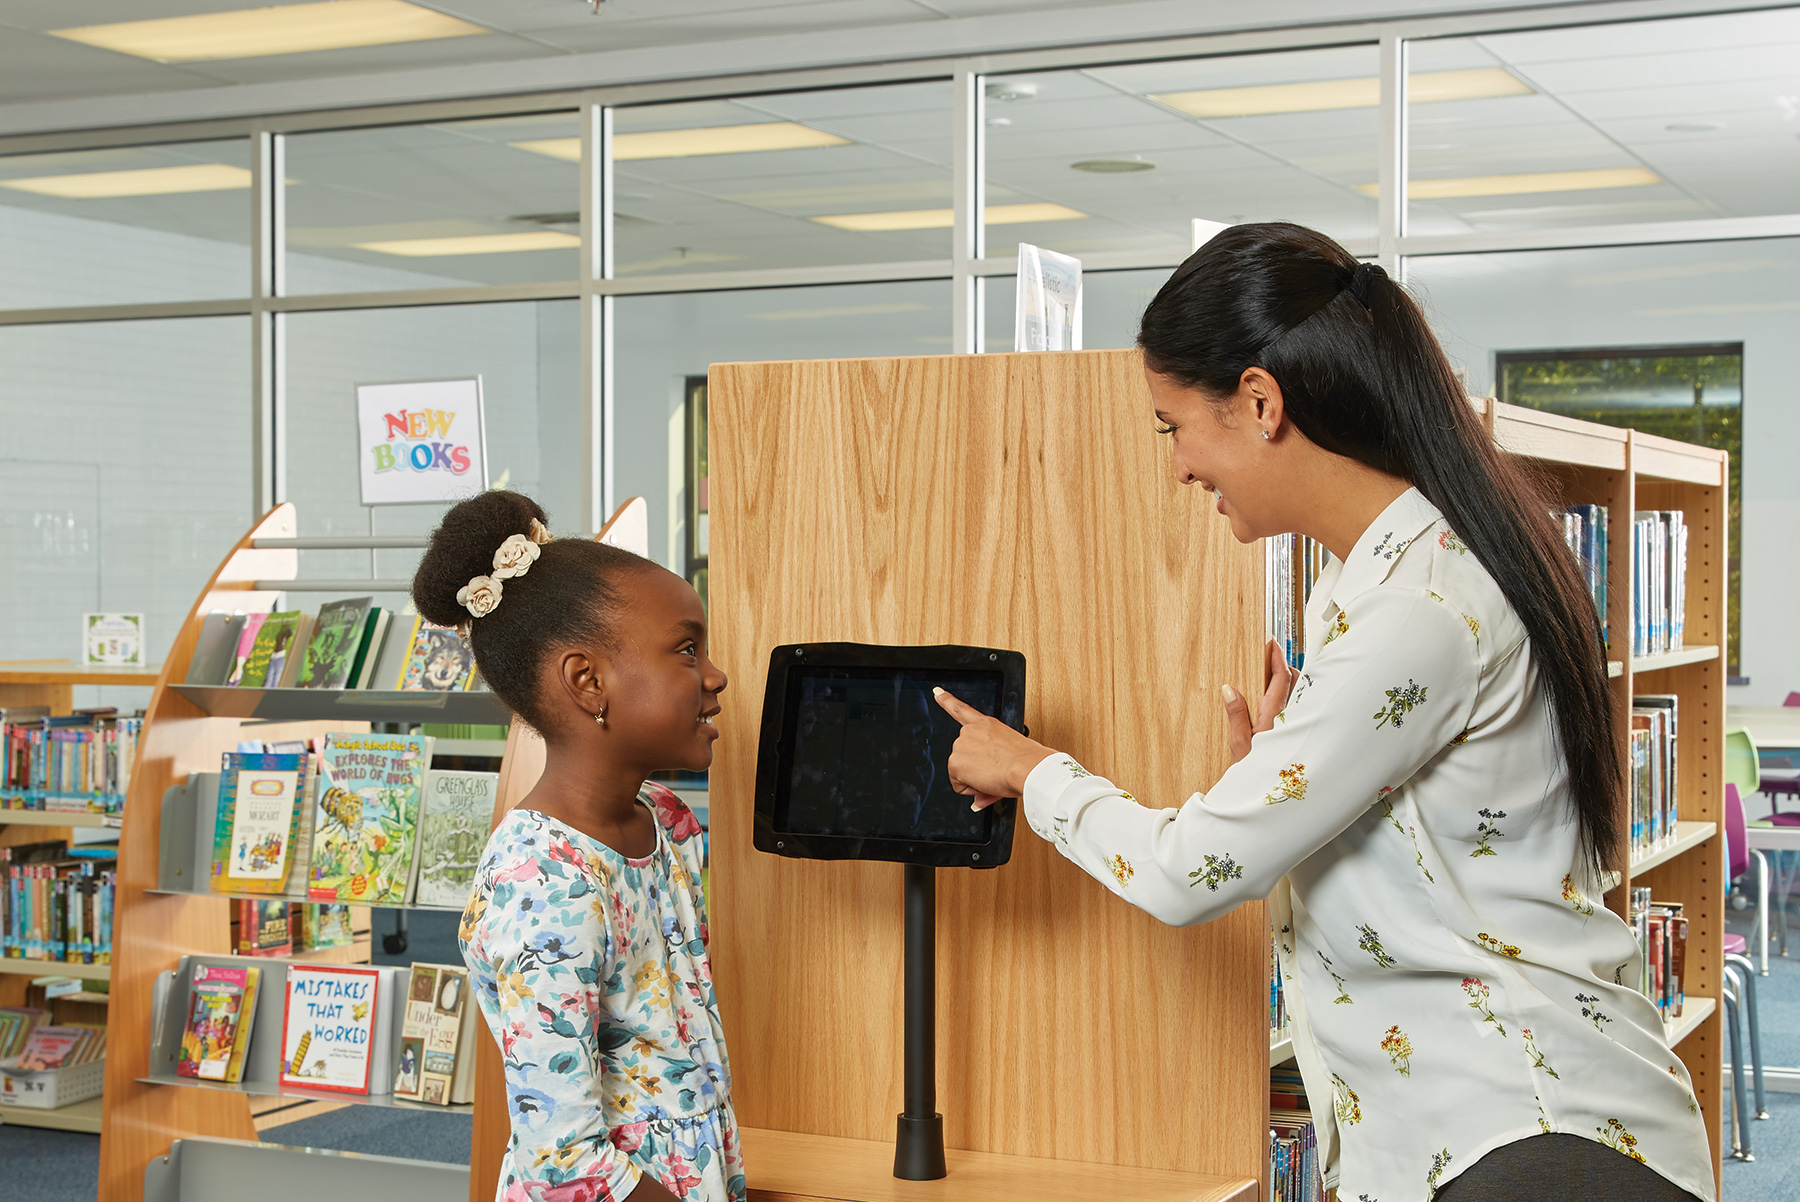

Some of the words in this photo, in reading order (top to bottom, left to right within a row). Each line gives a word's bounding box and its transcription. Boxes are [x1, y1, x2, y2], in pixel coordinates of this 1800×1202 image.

[384, 408, 456, 439] NEW
[373, 442, 471, 473] BOOKS
[335, 740, 361, 751] Magic
[364, 739, 390, 751] School
[390, 740, 406, 751] Bus
[335, 753, 388, 768] EXPLORES
[391, 758, 411, 771] THE
[331, 767, 367, 781] WORLD
[370, 768, 384, 781] OF
[386, 772, 414, 785] BUGS
[436, 776, 488, 796] GREENGLASS
[450, 794, 475, 810] HOUSE
[249, 811, 281, 821] MOZART
[294, 979, 369, 1000] MISTAKES
[307, 1003, 344, 1019] THAT
[407, 1002, 442, 1026] Under
[314, 1024, 368, 1045] WORKED
[428, 1028, 455, 1049] Egg
